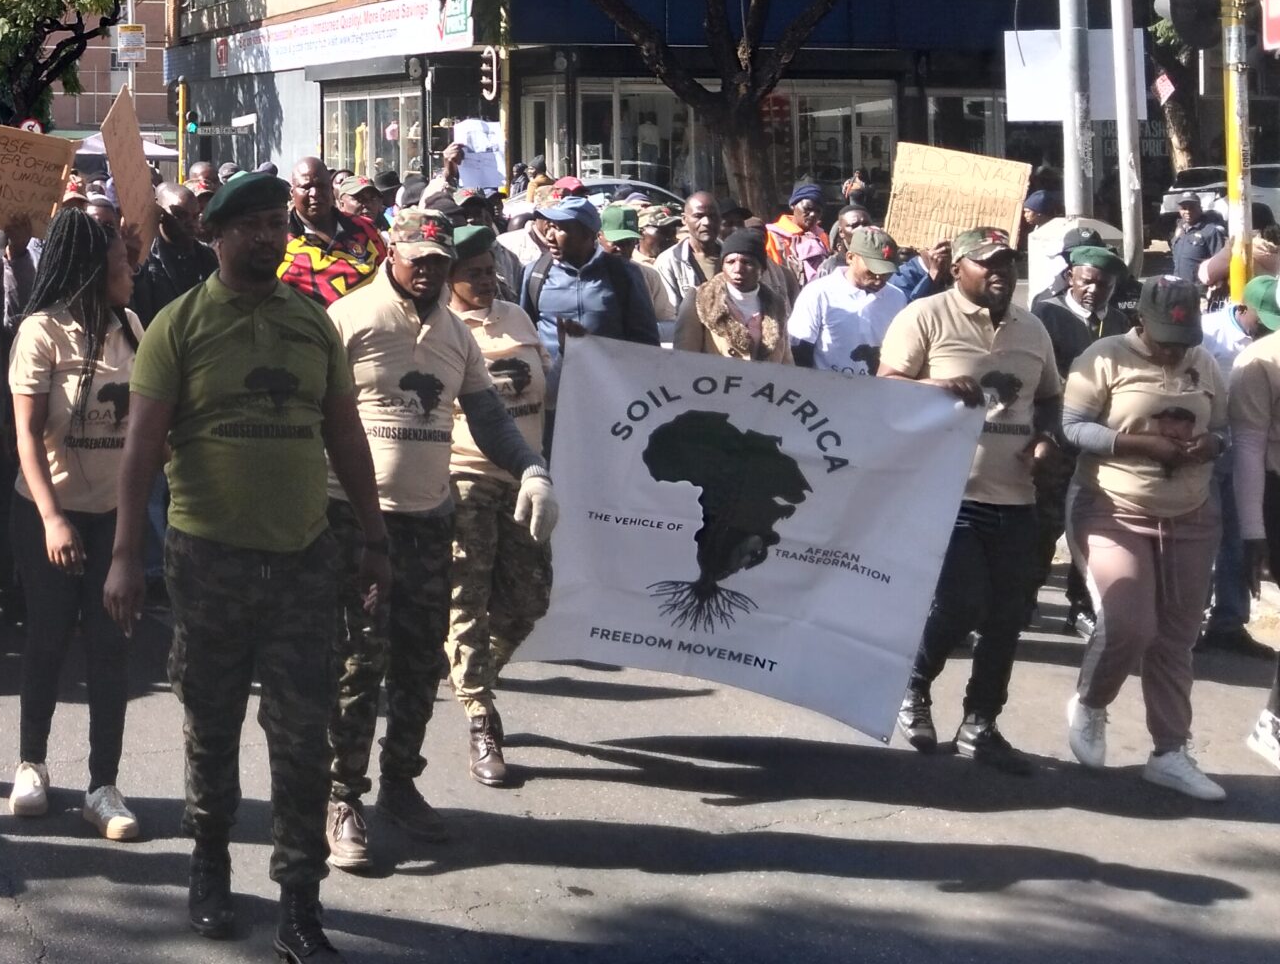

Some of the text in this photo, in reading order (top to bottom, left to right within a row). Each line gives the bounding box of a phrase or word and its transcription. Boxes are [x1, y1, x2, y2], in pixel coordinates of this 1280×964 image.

[23, 156, 44, 169] OF
[922, 148, 1028, 186] DONALD
[611, 375, 849, 474] SOIL OF AFRICA
[588, 511, 684, 532] THE VEHICLE OF
[775, 548, 891, 584] TRANSFORMATION
[804, 547, 861, 563] AFRICAN
[589, 626, 778, 672] FREEDOM MOVEMENT
